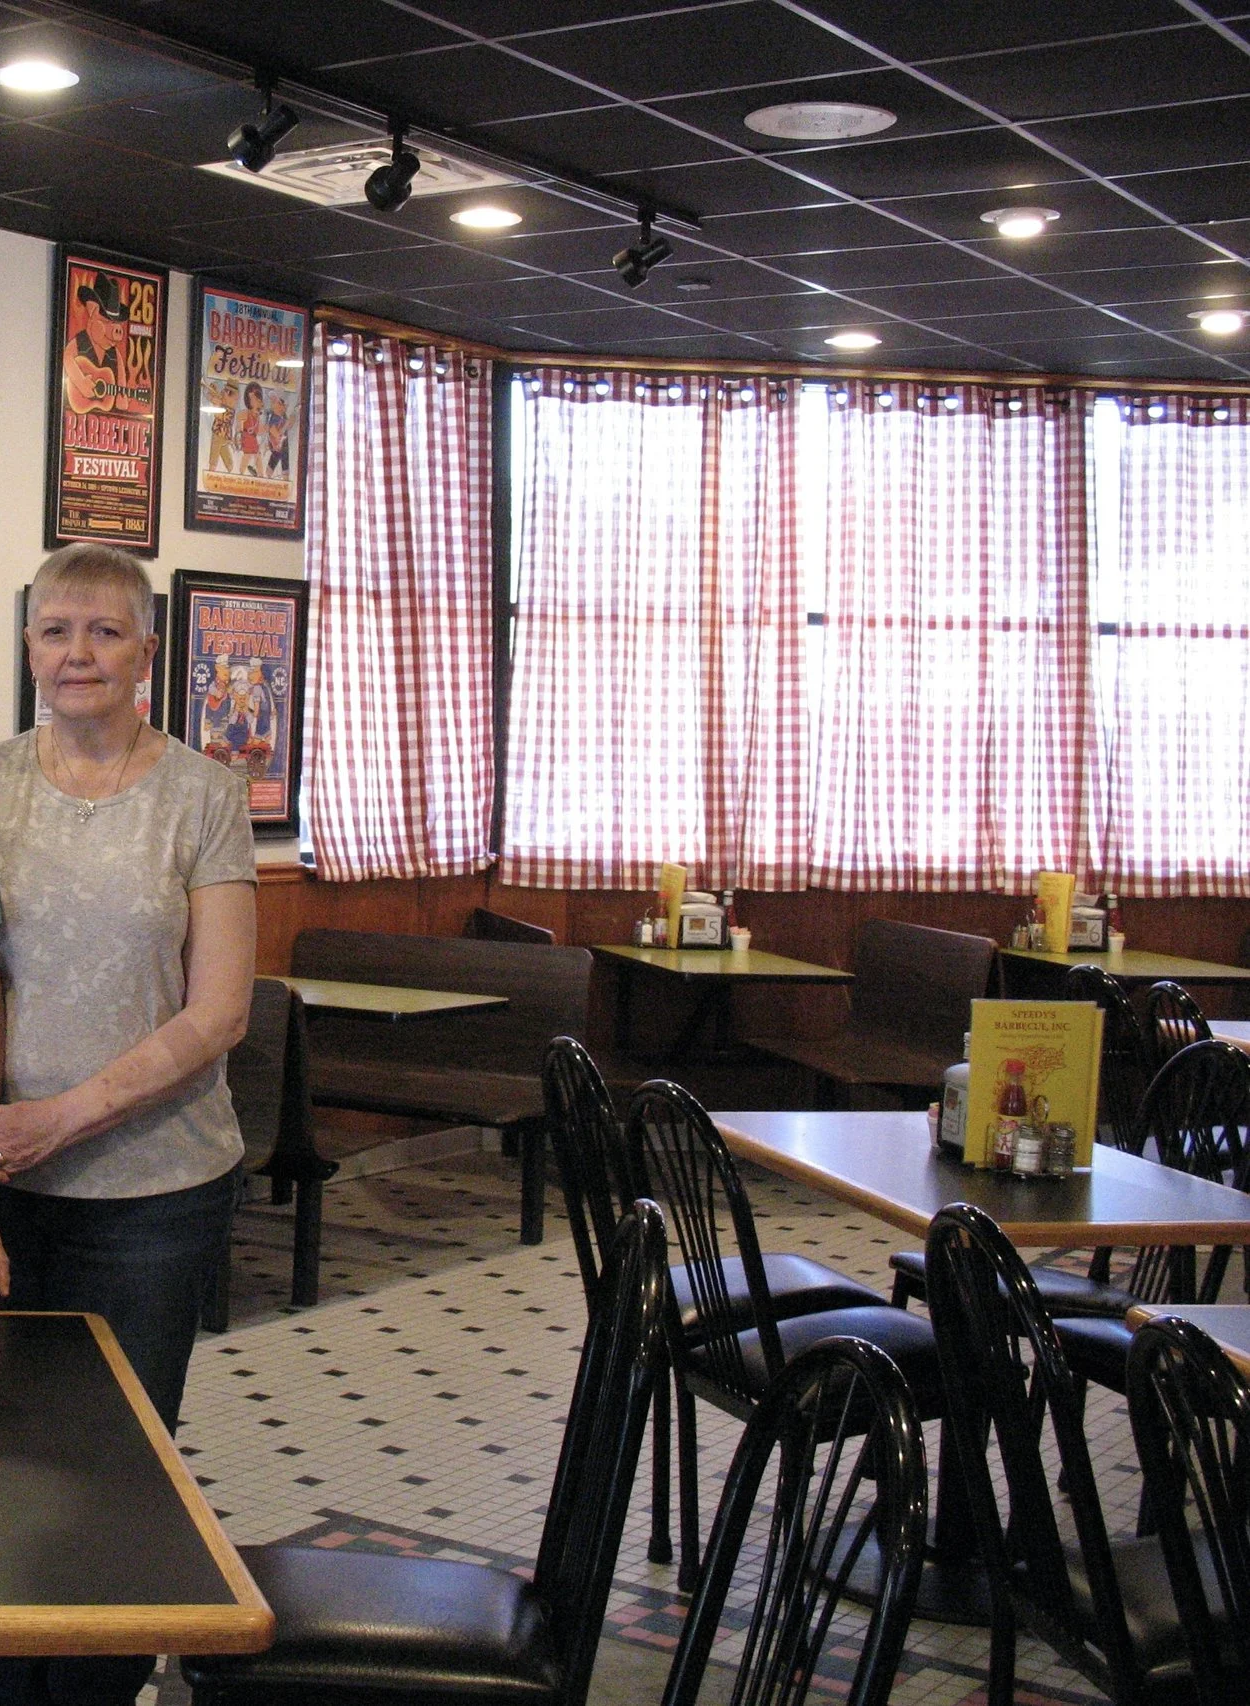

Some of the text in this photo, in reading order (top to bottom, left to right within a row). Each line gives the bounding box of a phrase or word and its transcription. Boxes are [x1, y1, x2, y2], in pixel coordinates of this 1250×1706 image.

[129, 281, 154, 325] 26
[210, 309, 298, 357] BARBECUE
[64, 410, 150, 457] BARBECUE
[73, 457, 139, 477] FESTIVAL
[199, 606, 287, 634] BARBECUE
[202, 631, 282, 657] FESTIVAL
[196, 673, 207, 684] 26
[709, 921, 718, 940] 5
[1091, 924, 1100, 943] 6
[1012, 1010, 1056, 1019] SPEEDY'S
